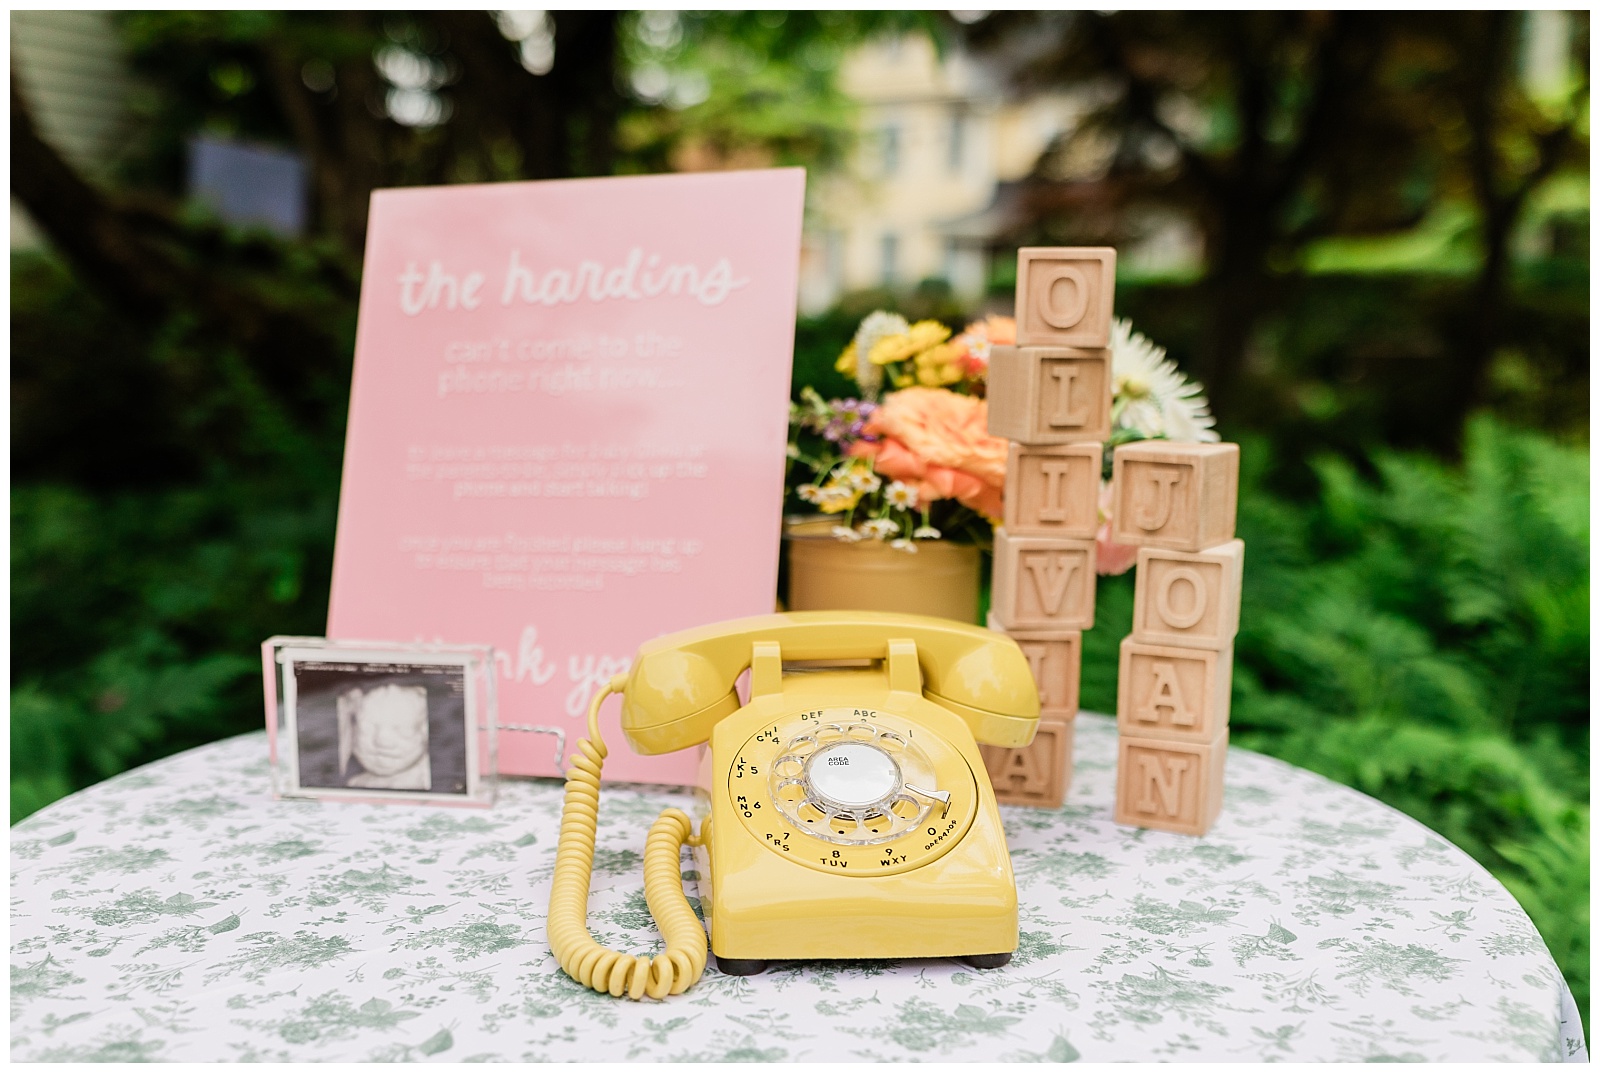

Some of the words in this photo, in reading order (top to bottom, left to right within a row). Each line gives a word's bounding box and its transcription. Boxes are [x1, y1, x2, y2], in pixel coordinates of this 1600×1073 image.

[397, 260, 486, 316] the
[444, 335, 511, 363] can't
[516, 334, 592, 361] come
[599, 332, 629, 359] to
[633, 329, 684, 358] the
[437, 364, 525, 399] phone
[527, 361, 594, 397] right
[565, 655, 632, 718] yo
[801, 710, 824, 721] DEF
[853, 709, 878, 719] ABC
[771, 736, 780, 745] 4
[750, 766, 759, 775] 5
[753, 801, 762, 809] 6
[783, 832, 790, 840] 7
[924, 819, 957, 851] OPERATOR
[766, 833, 790, 852] PRS
[832, 850, 841, 859] 8
[885, 848, 893, 857] 9
[820, 858, 848, 868] TUV
[880, 855, 907, 867] WXY
